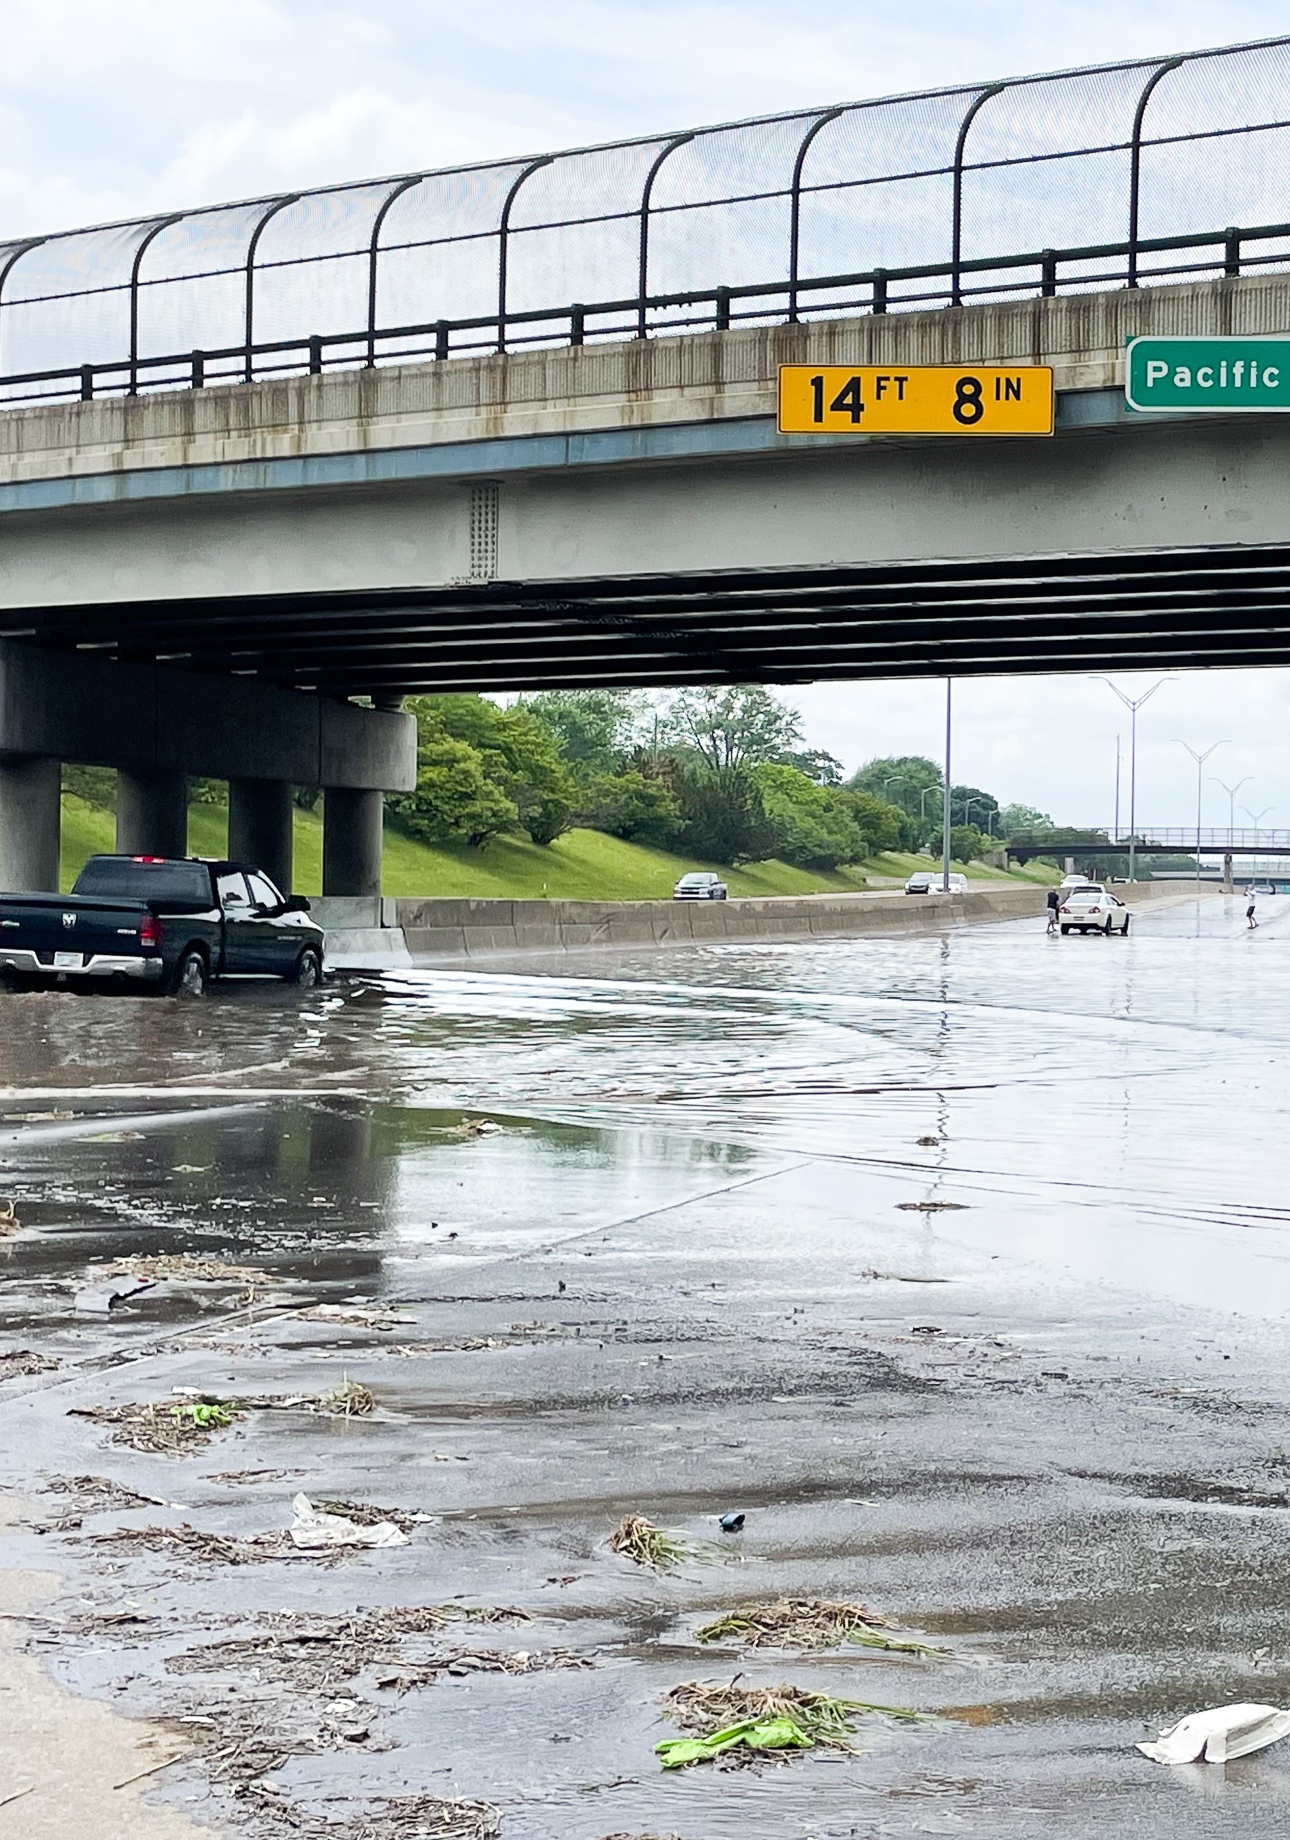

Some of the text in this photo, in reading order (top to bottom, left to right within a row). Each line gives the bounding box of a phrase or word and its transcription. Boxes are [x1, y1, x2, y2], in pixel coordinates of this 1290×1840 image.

[1145, 359, 1280, 389] Pacific
[810, 374, 1021, 426] 14 FT 8 IN
